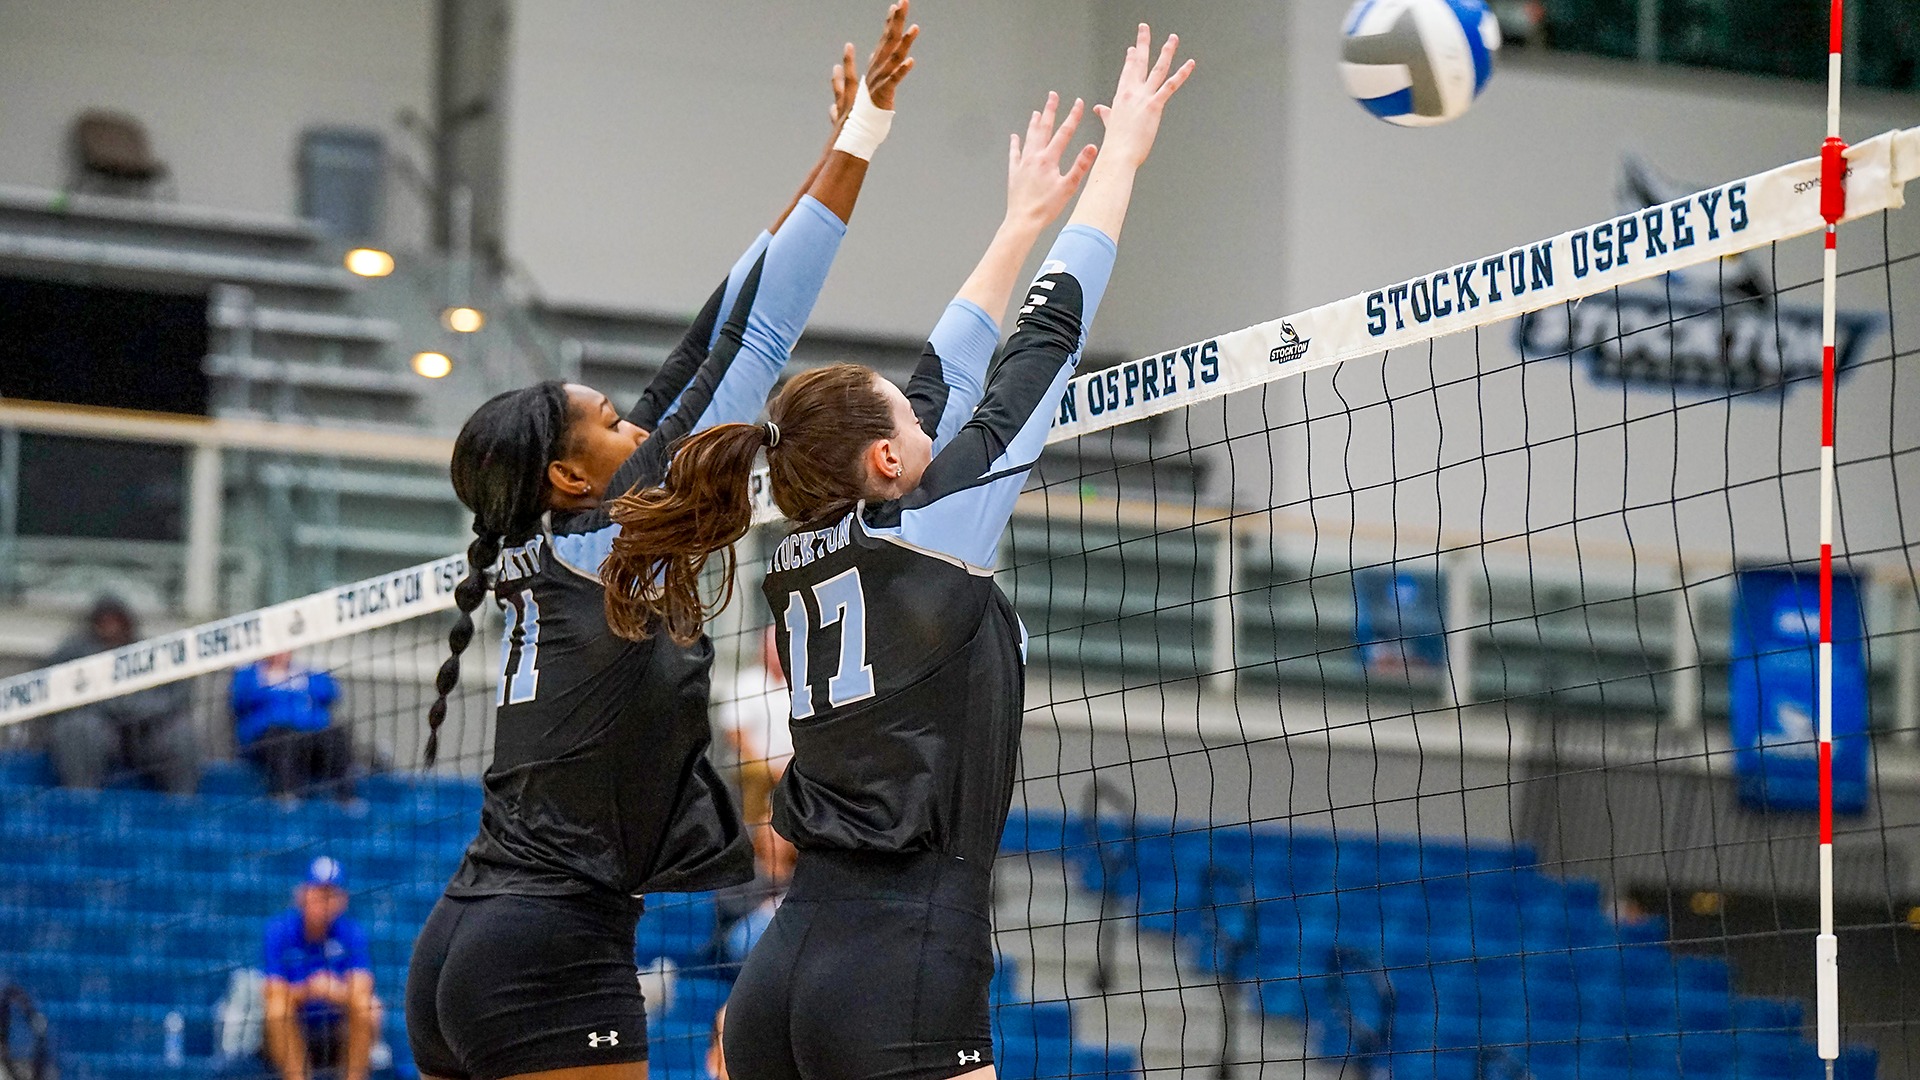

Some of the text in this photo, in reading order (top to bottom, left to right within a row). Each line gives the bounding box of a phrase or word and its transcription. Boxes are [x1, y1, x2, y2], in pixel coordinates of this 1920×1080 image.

[1366, 181, 1750, 337] STOCKTON OSPREYS
[1087, 340, 1219, 416] OSPREYS
[1271, 342, 1308, 361] STOCKTON
[766, 511, 855, 574] TOCKTON
[496, 588, 541, 708] 11
[783, 565, 877, 720] 17
